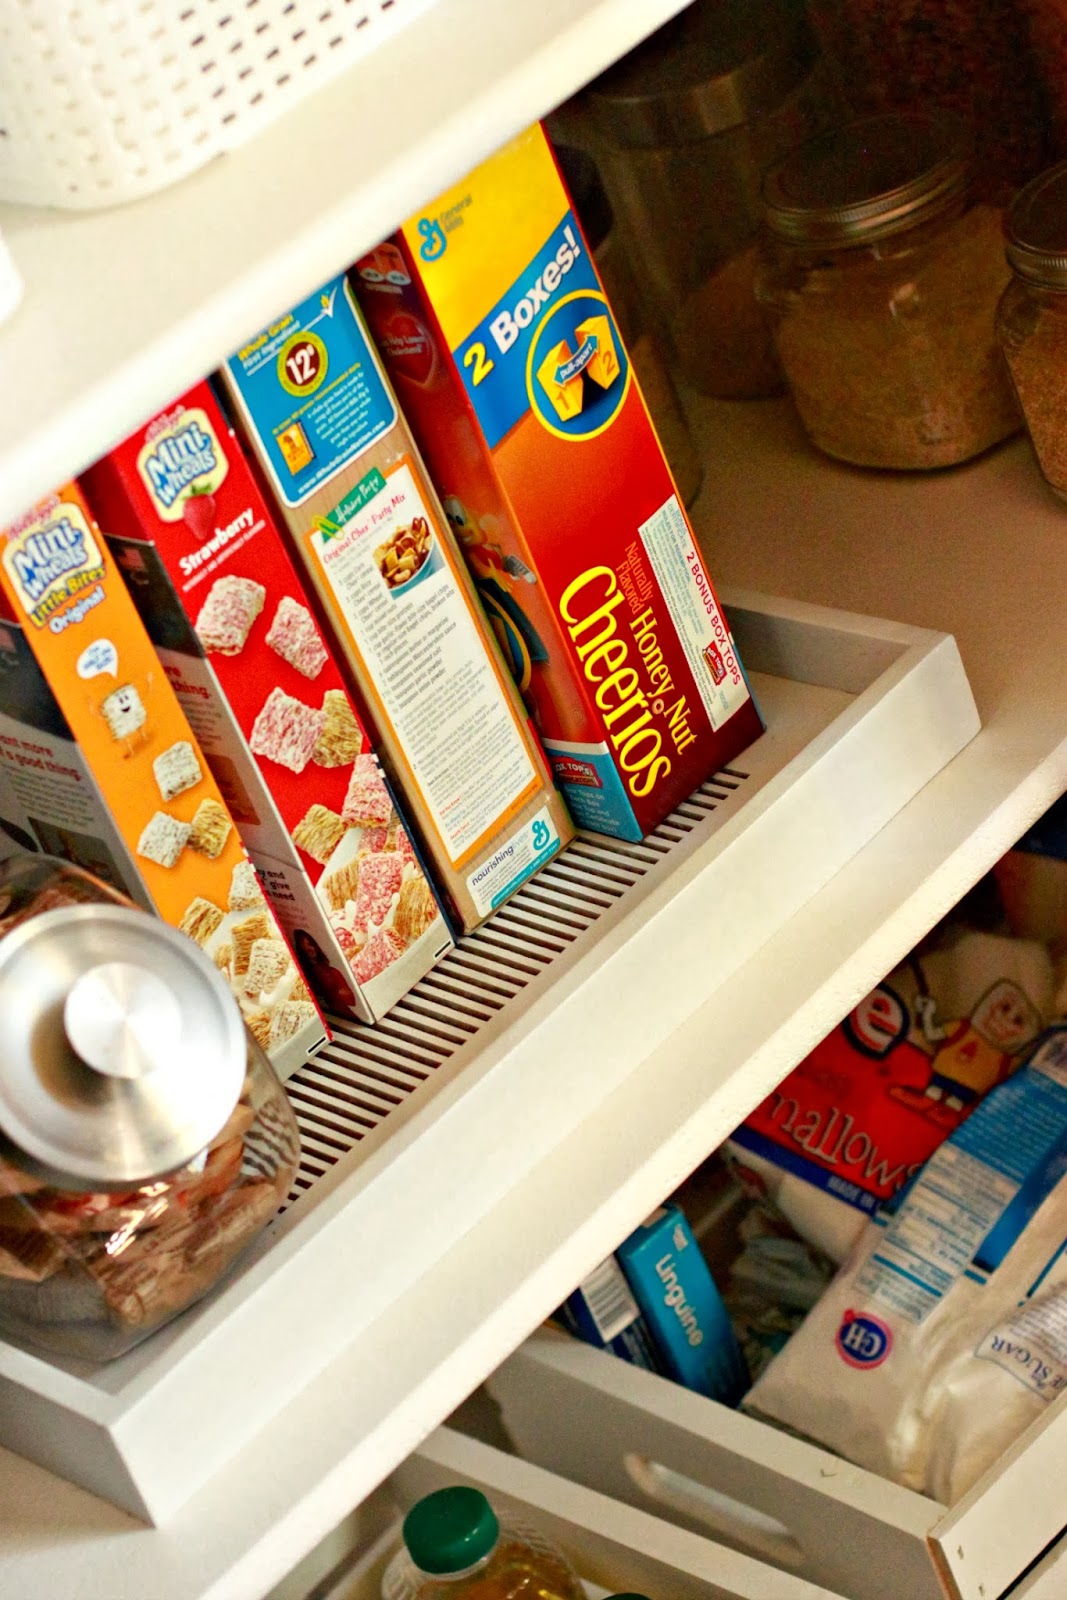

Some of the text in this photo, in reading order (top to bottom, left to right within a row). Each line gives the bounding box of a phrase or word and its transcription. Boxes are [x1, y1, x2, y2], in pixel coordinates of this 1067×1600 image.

[463, 224, 582, 387] 2 Boxes!
[603, 350, 616, 377] 2
[145, 421, 210, 487] Mini
[390, 490, 406, 508] Mix
[13, 517, 82, 578] Mini
[179, 507, 255, 576] Strawberry
[625, 541, 654, 603] Naturally
[616, 561, 644, 615] Flavored
[686, 551, 695, 563] 2
[691, 563, 715, 615] BONUS
[711, 615, 727, 647] BOX
[723, 647, 741, 685] TOPS
[559, 565, 672, 797] Cheerios
[630, 606, 675, 698] Honey
[663, 695, 697, 755] Nut
[655, 1252, 704, 1347] Linguine
